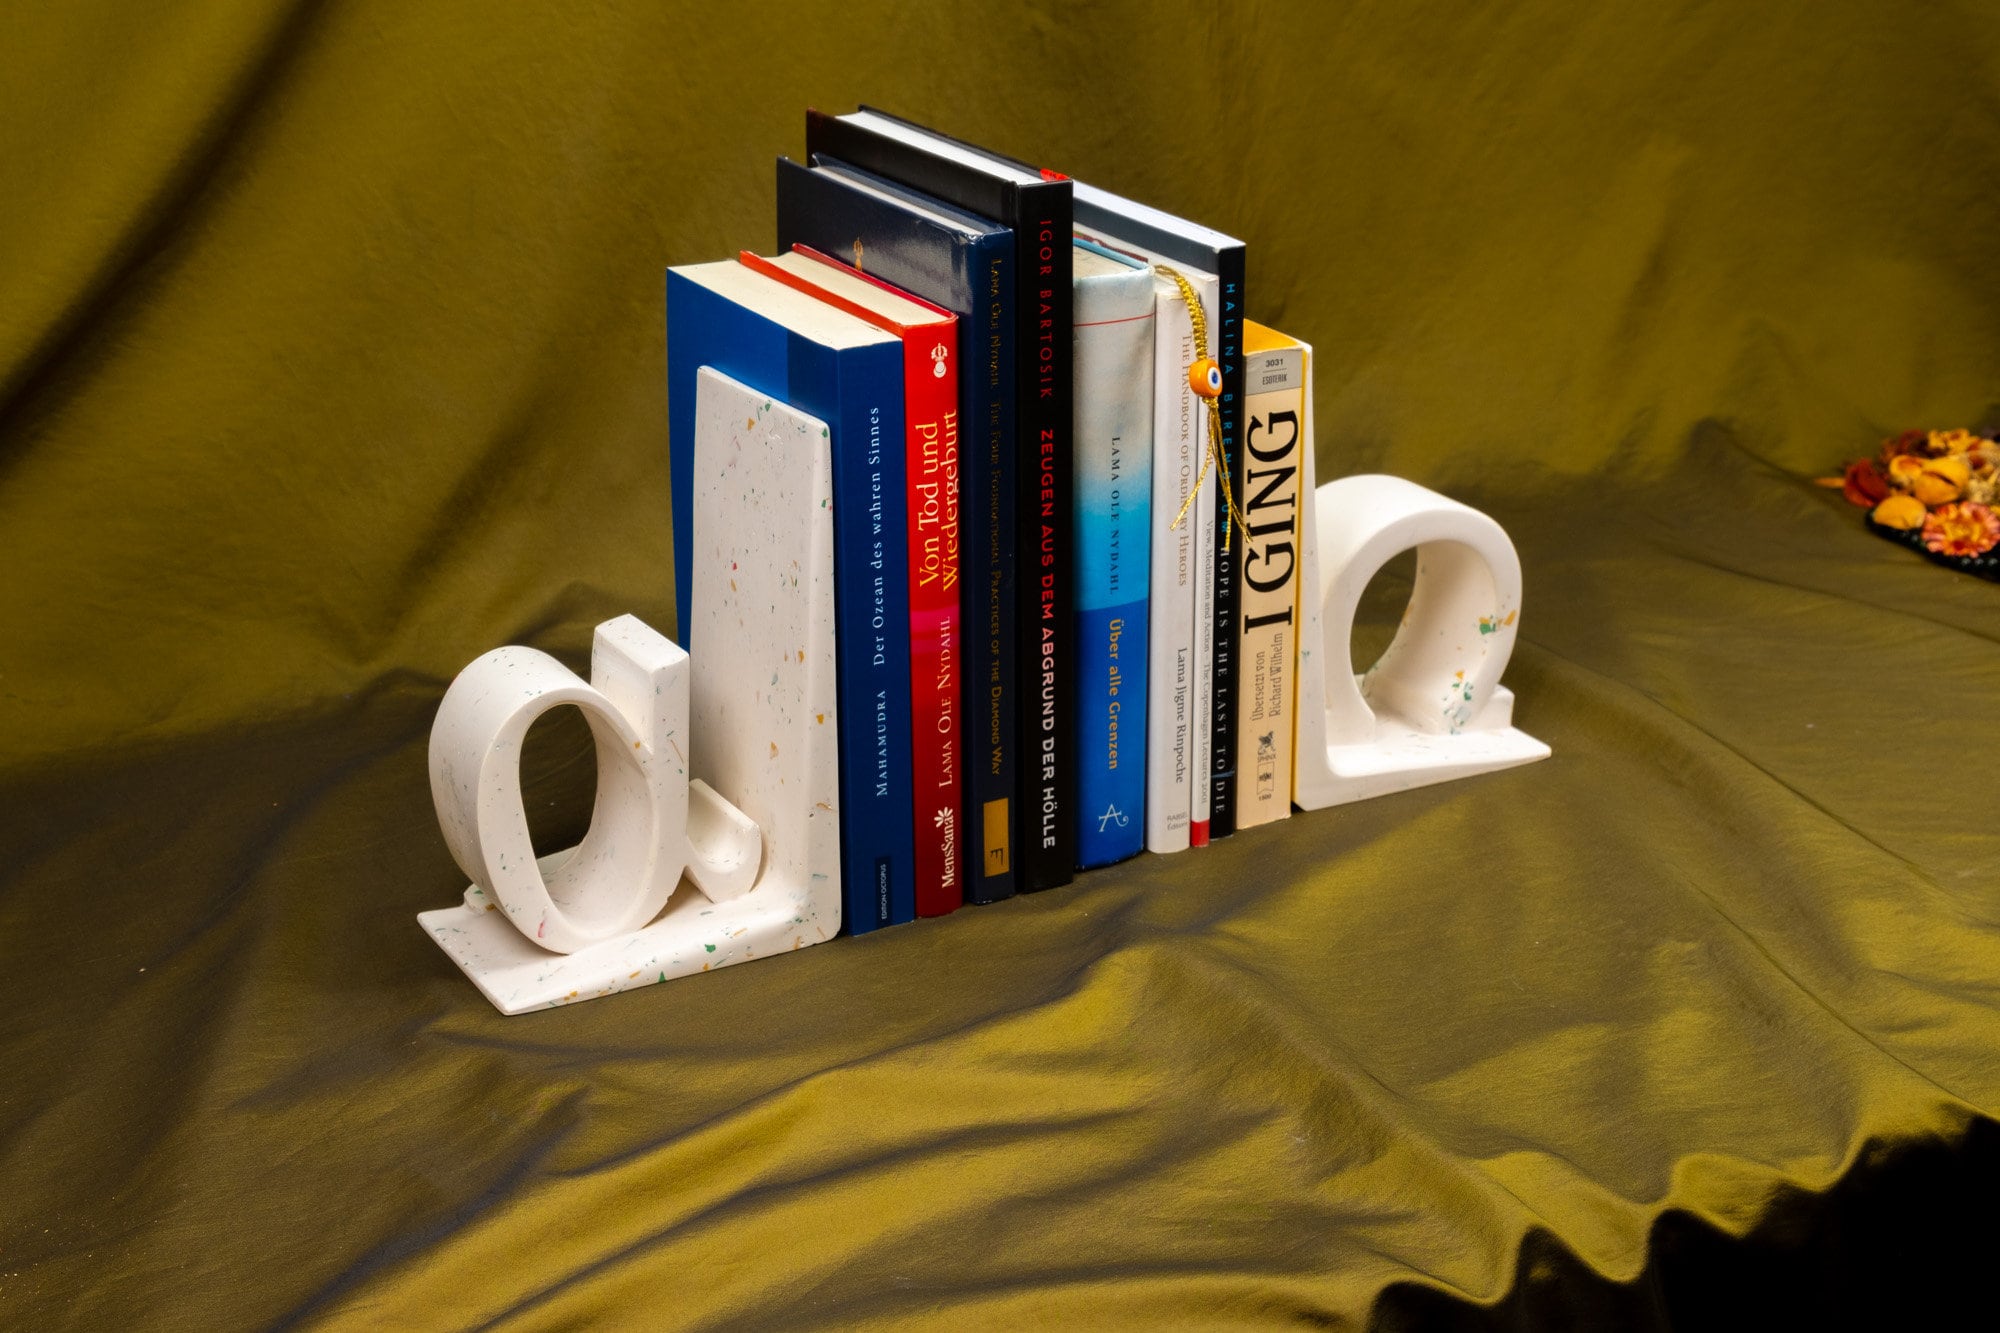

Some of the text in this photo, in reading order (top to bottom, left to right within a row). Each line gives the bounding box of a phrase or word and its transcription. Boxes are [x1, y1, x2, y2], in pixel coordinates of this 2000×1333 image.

[1040, 219, 1053, 398] IGOR BARTOSIK
[1181, 334, 1192, 362] THE
[1225, 283, 1235, 374] HALINA
[1181, 365, 1190, 441] HANDBOOK
[1262, 373, 1287, 386] ESOTERIK
[1265, 358, 1284, 368] 3031
[1180, 445, 1189, 464] OF
[868, 407, 885, 666] Der Ozean des wahren Sinnes
[915, 421, 940, 587] Von Tod und
[940, 409, 959, 592] Wiedergeburt
[1109, 436, 1121, 595] LAMA OLE NYDAHL
[1243, 410, 1298, 634] I GING
[990, 570, 1002, 635] PRACTICES
[1179, 535, 1189, 586] HEROES
[991, 639, 999, 656] OF
[991, 659, 1000, 682] THE
[1041, 429, 1058, 849] ZEUGEN AUS DEM ABGRUND DER HÖLLE
[1215, 547, 1231, 813] HOPE IS THE LAST TO DIE
[1268, 632, 1283, 718] Richard Wilhelm
[937, 616, 953, 787] LAMA OLE NYDAHL
[991, 686, 1003, 744] DIAMOND
[1108, 618, 1124, 769] Über alle Grenzen
[1173, 647, 1188, 784] Lama Jigme Rinpoche
[1250, 651, 1265, 721] Übersetzt von
[876, 690, 888, 796] MAHAMUDRA
[991, 746, 1003, 775] WAY
[941, 814, 955, 888] MensSana
